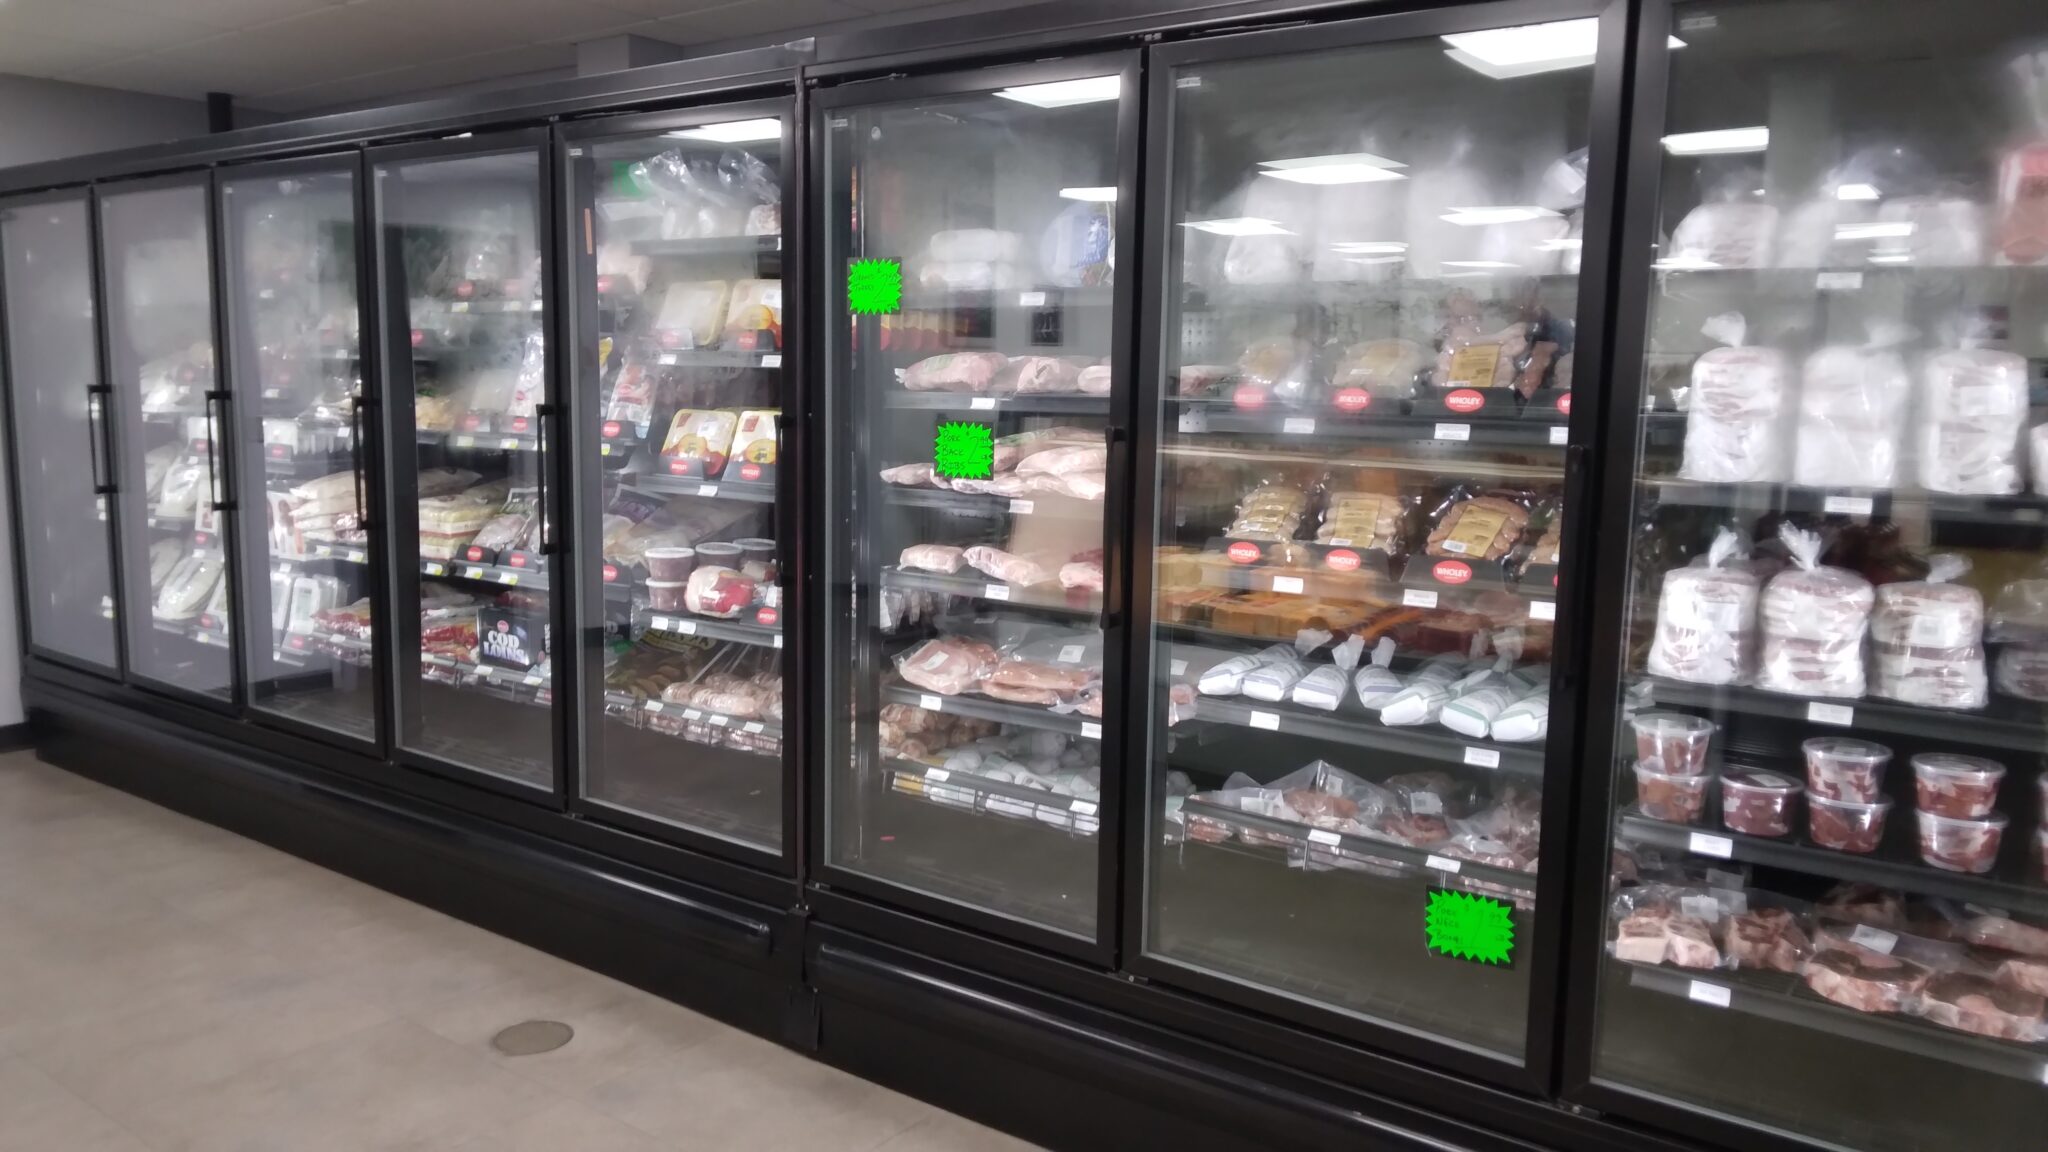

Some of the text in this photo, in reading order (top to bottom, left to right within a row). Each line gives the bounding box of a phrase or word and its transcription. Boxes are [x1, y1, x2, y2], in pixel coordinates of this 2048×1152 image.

[1449, 396, 1481, 406] WHOLEY
[1436, 567, 1469, 578] WHOLEY
[487, 630, 520, 649] COD
[483, 641, 525, 663] LOINS
